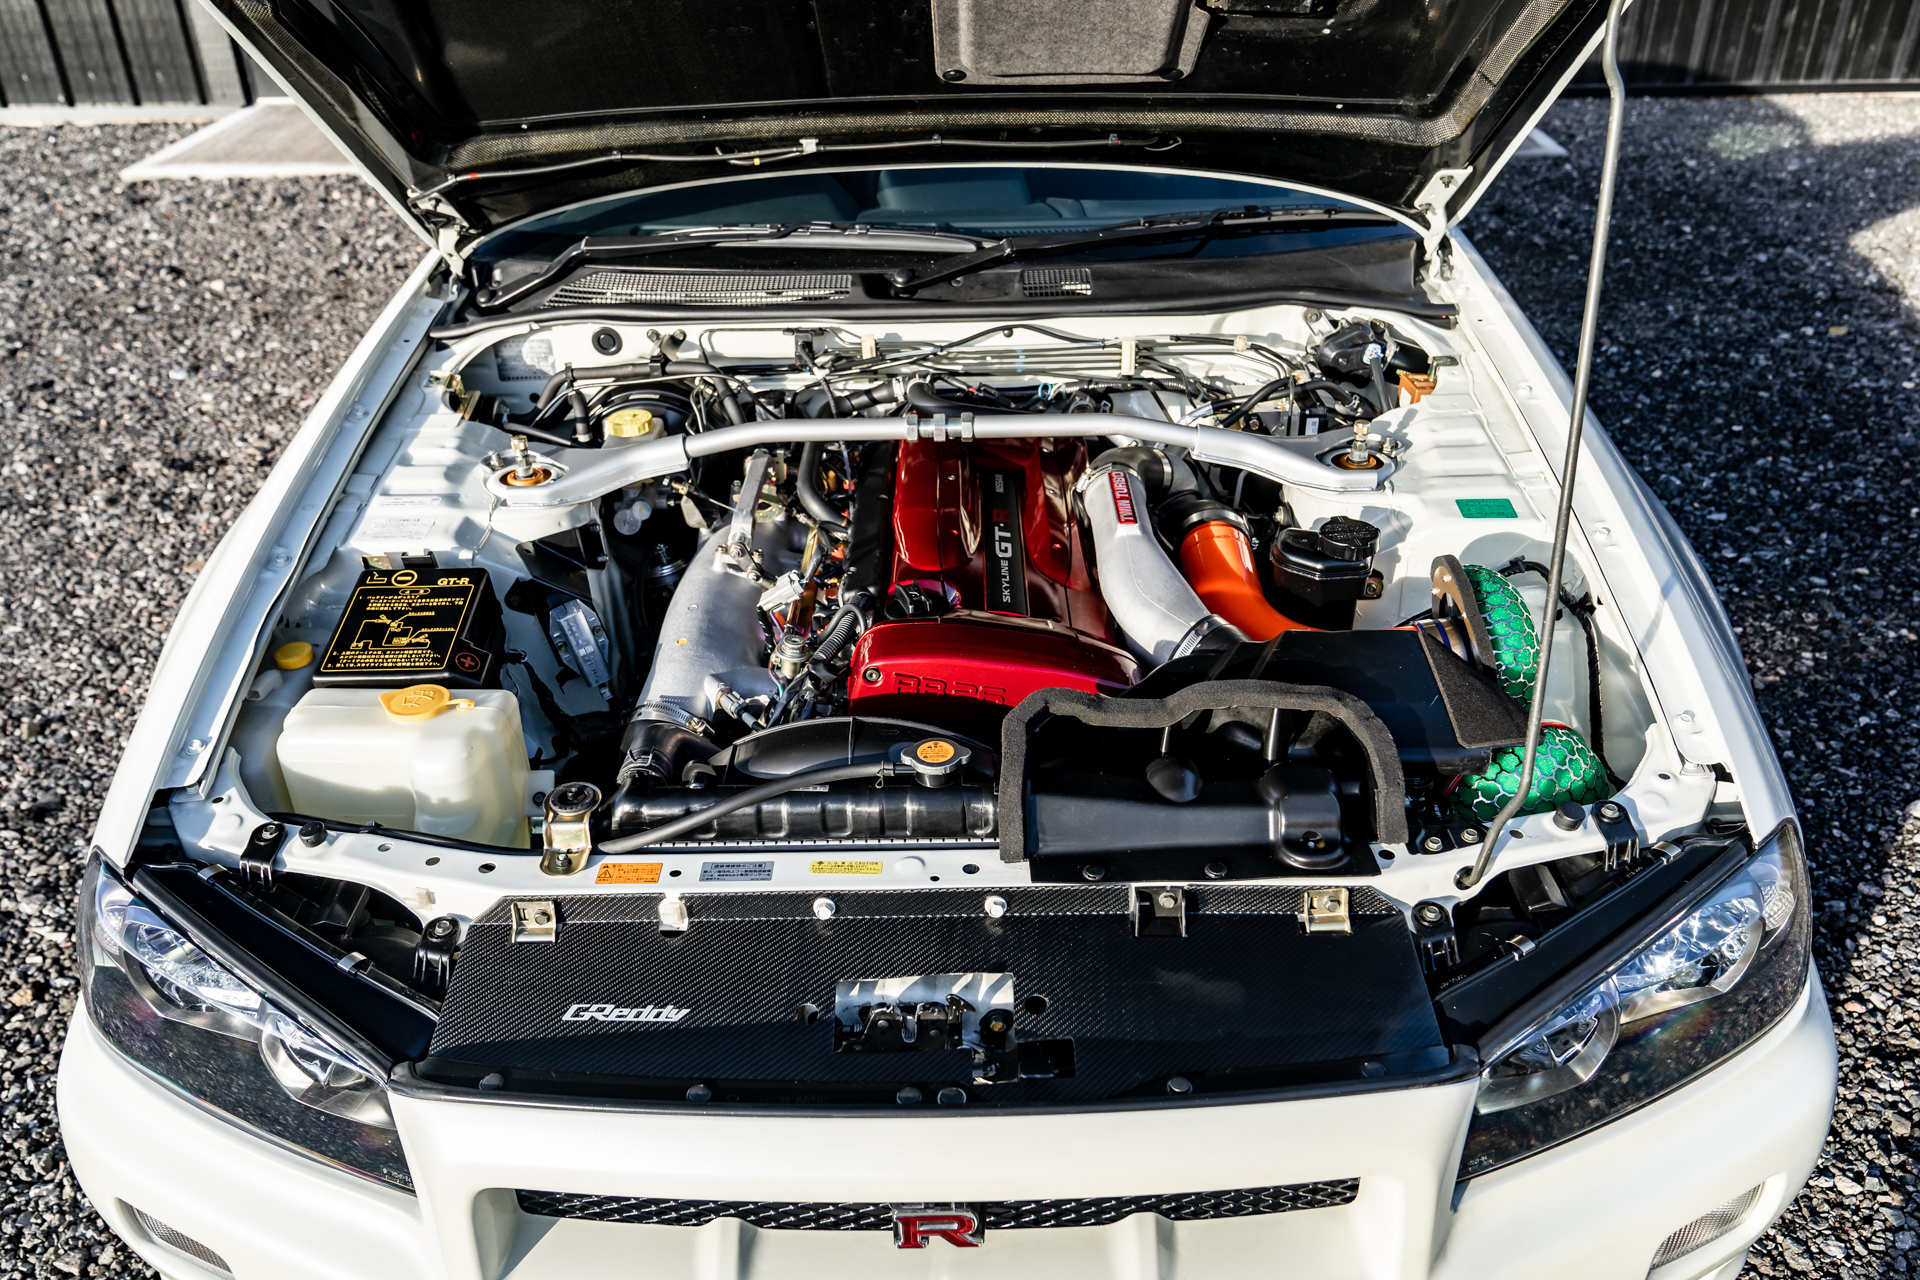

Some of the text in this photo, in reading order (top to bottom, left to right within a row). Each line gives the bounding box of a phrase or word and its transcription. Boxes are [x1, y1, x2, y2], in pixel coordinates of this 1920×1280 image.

[994, 474, 1005, 493] NISSAN
[1112, 471, 1134, 521] TWIN TURBO
[437, 577, 470, 586] GT-R
[1001, 559, 1011, 603] SKYLINE
[562, 1003, 691, 1022] GReddy
[893, 1210, 983, 1249] R
